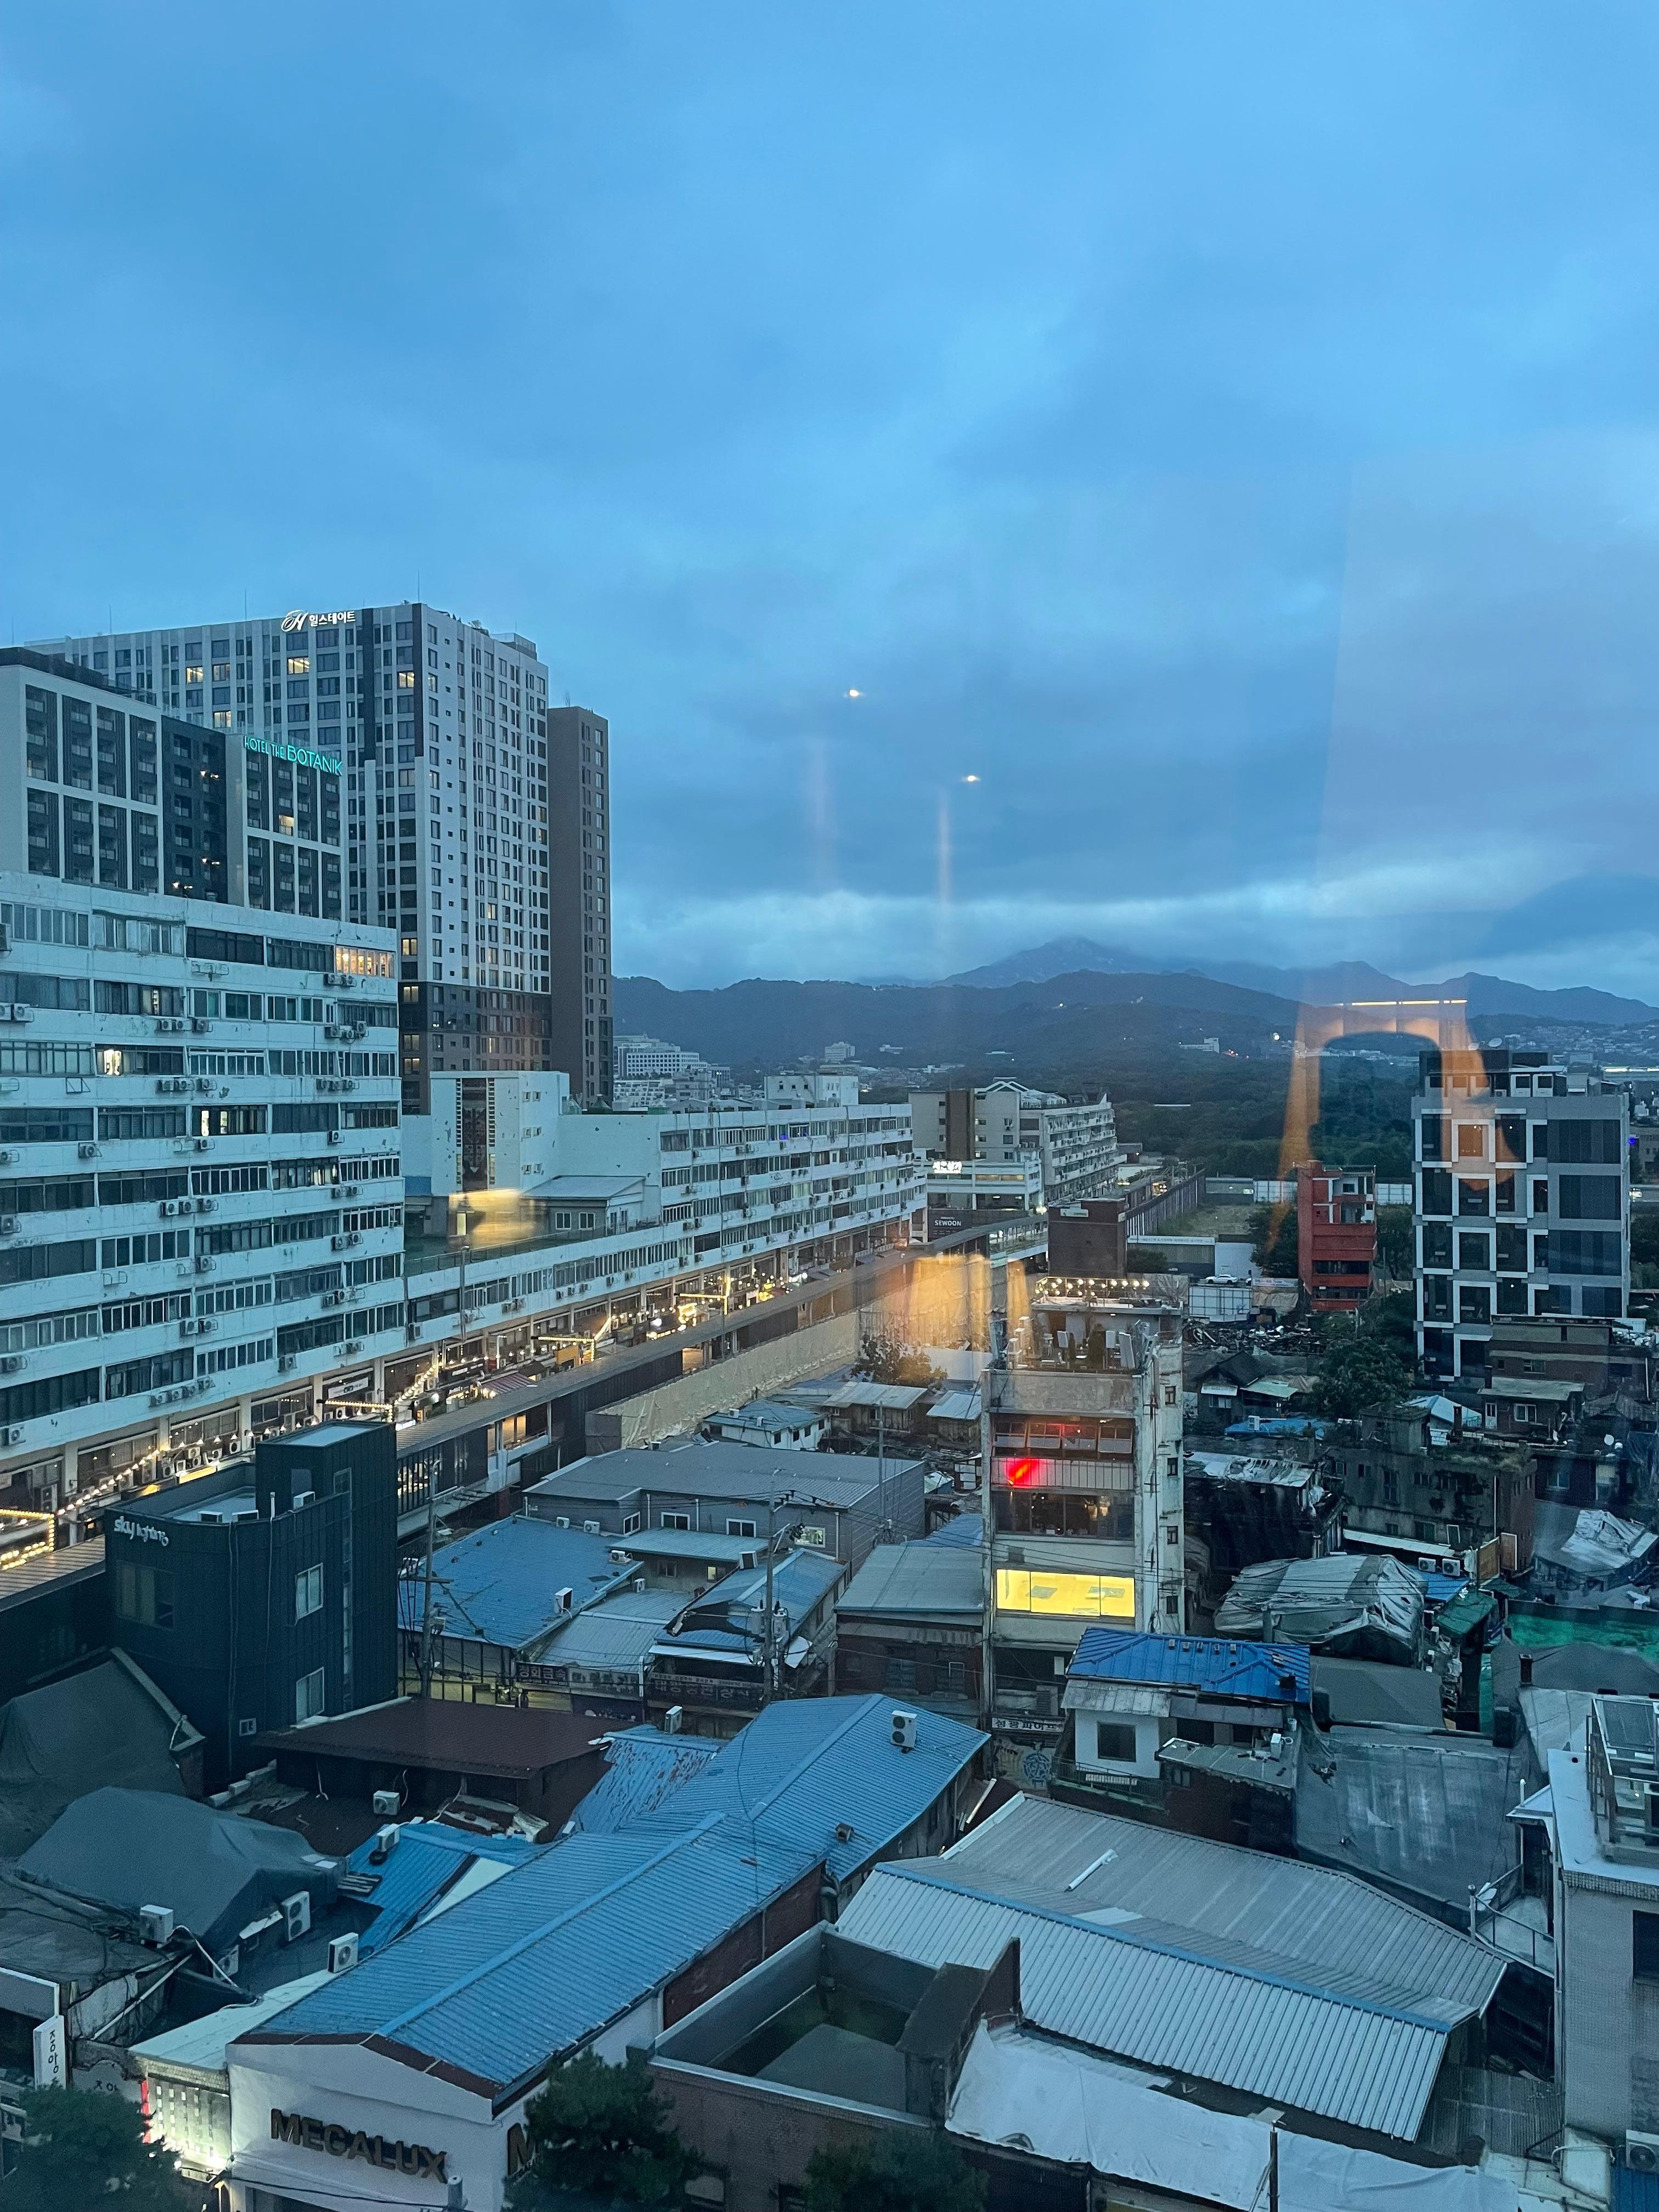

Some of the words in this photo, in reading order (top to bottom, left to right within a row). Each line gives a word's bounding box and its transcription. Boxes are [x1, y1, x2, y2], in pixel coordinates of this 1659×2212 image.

[244, 735, 269, 754] HOTEL
[270, 743, 284, 759] THE
[286, 744, 343, 776] BOTANIK
[270, 2108, 447, 2185] MEGALUX
